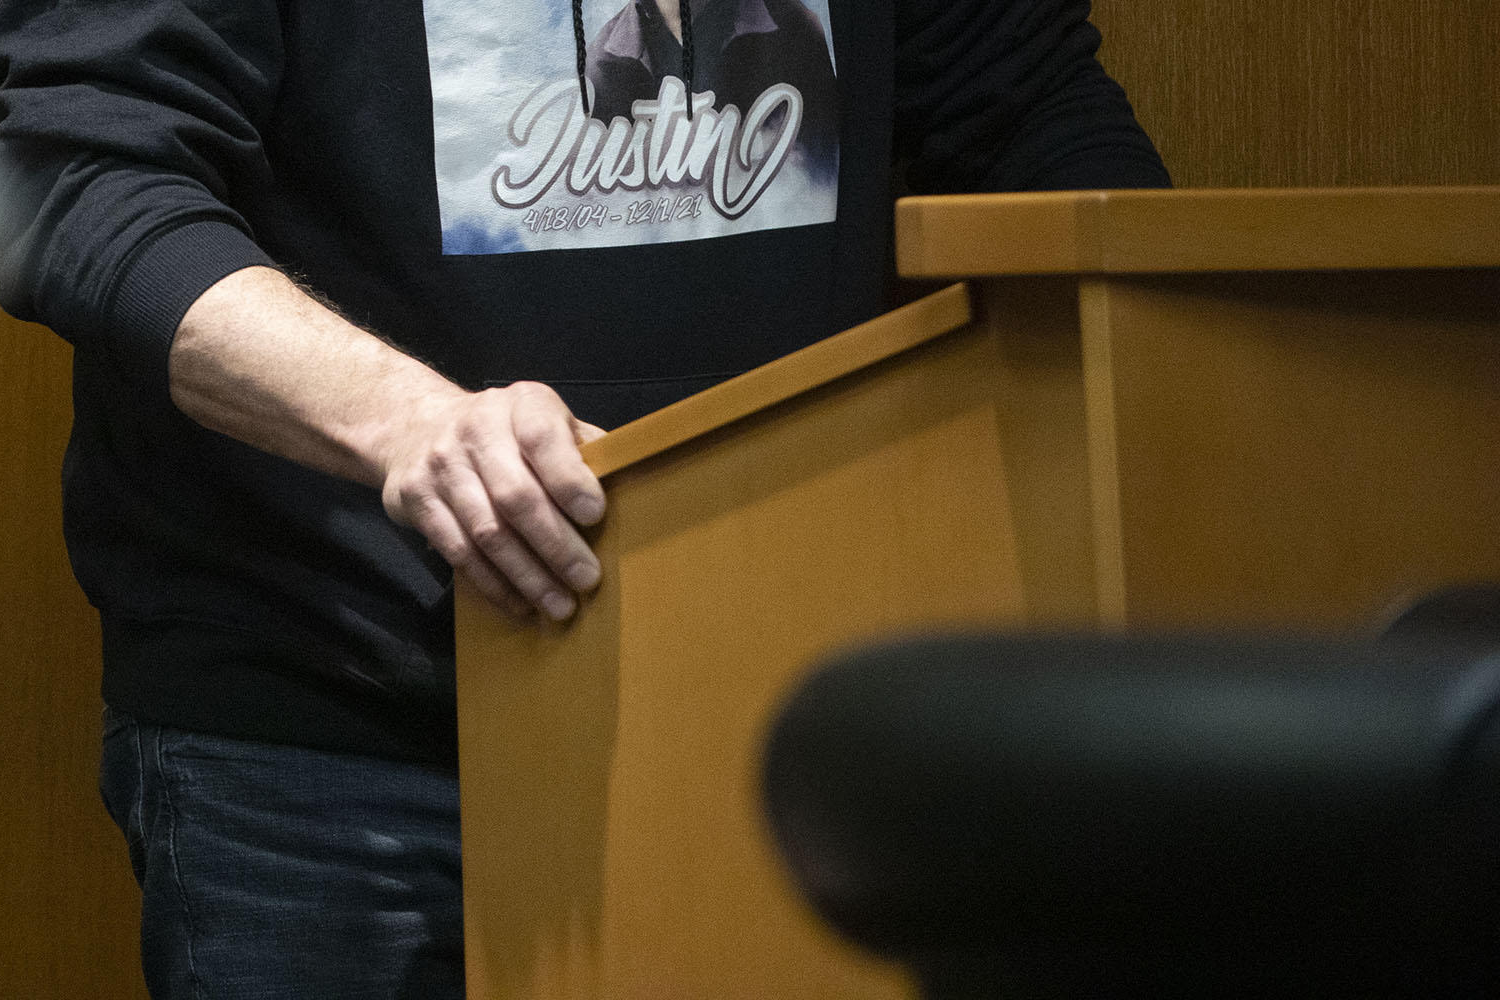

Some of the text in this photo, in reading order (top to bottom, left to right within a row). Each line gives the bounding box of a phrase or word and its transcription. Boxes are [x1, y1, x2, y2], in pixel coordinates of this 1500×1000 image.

[492, 75, 803, 220] Justin
[522, 204, 609, 232] 4/18/04
[627, 193, 704, 226] 12/1/21
